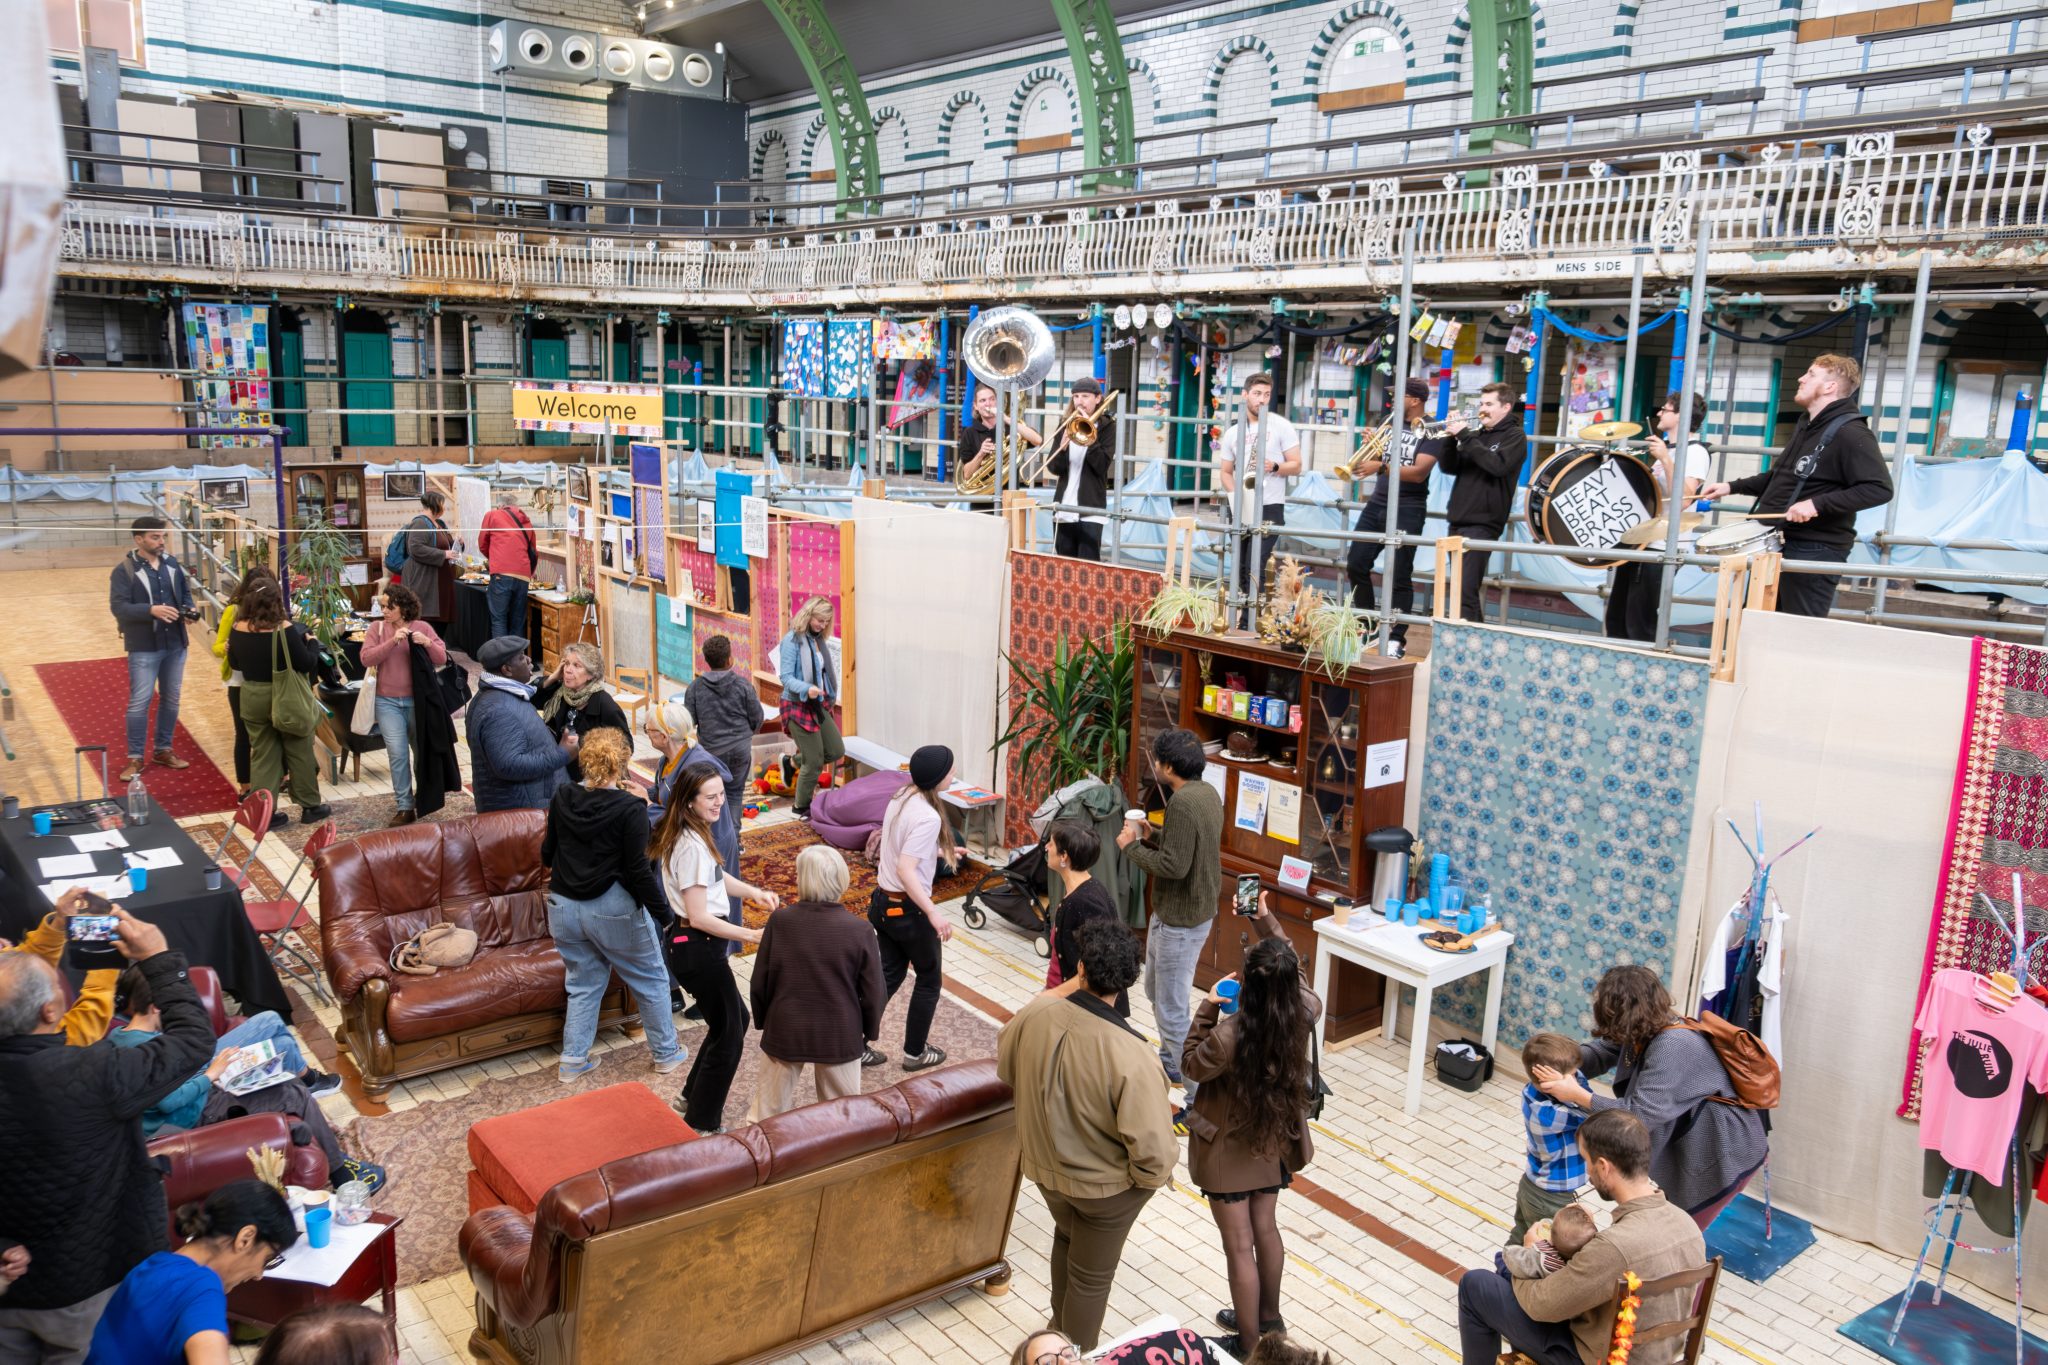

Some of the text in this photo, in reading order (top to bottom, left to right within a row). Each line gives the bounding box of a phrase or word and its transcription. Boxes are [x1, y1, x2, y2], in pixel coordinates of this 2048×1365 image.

[1556, 261, 1622, 273] MENS SIDE
[771, 291, 808, 304] SHALLOW END
[1943, 391, 1950, 399] 2
[537, 394, 637, 421] Welcome
[1555, 461, 1617, 515] HEAVY
[1564, 487, 1610, 530] BEAT
[1574, 496, 1633, 545] BRASS
[1952, 1031, 1993, 1053] THE JULIE
[1980, 1053, 1996, 1077] RUIN
